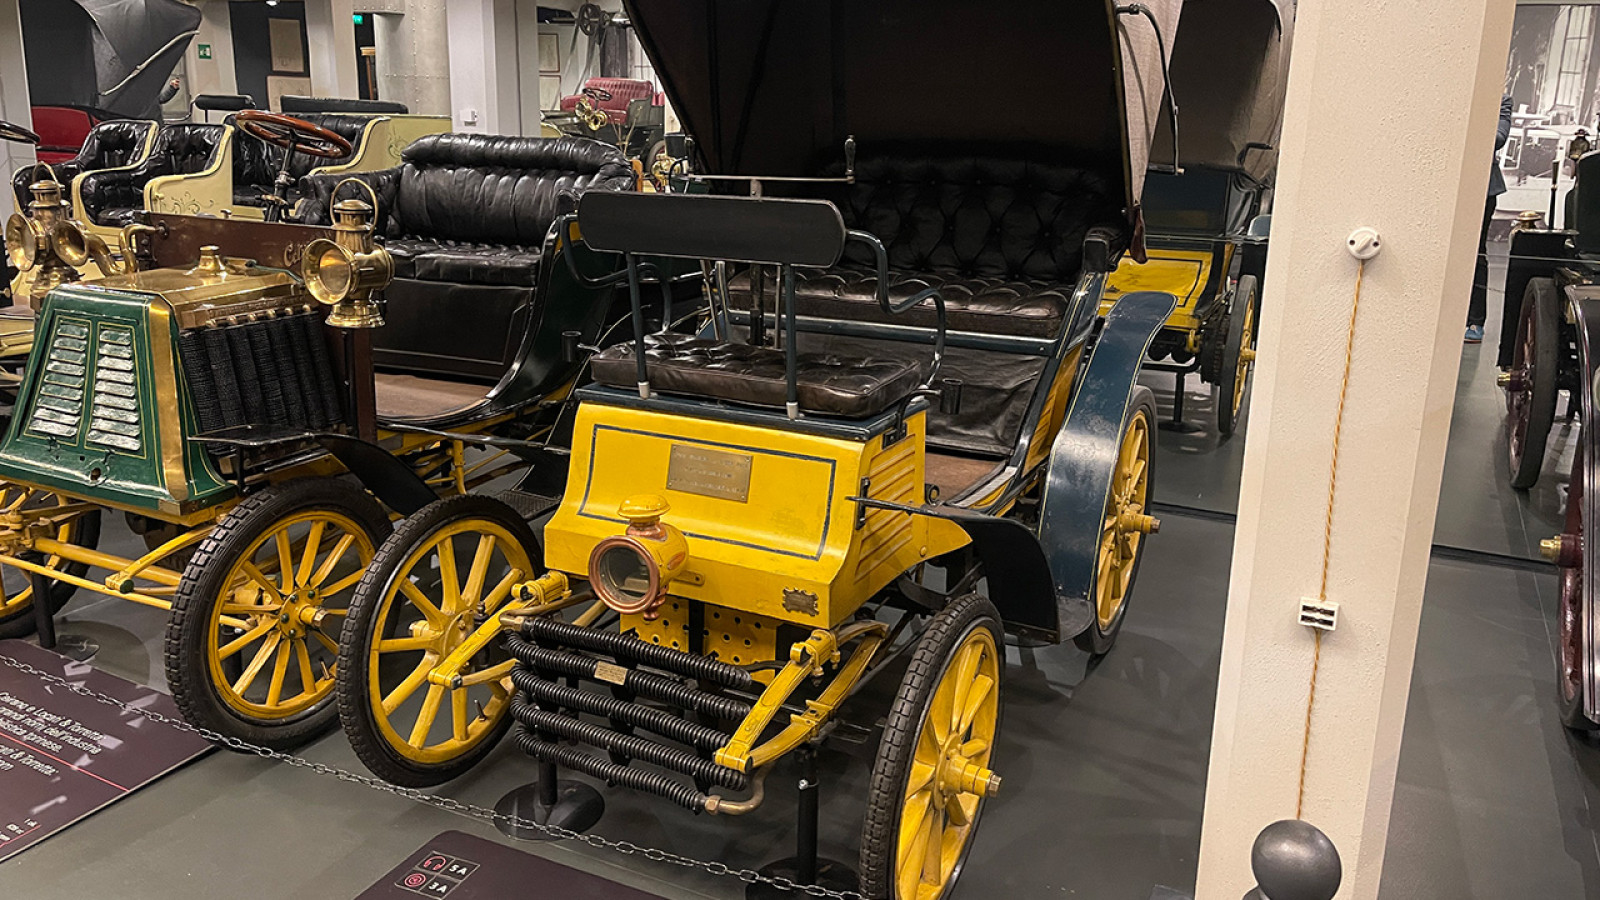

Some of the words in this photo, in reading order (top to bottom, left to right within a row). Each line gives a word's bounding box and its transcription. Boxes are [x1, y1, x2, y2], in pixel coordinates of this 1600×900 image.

[21, 717, 51, 733] nomi
[59, 719, 72, 727] &
[10, 751, 25, 759] &
[428, 881, 447, 893] 3A
